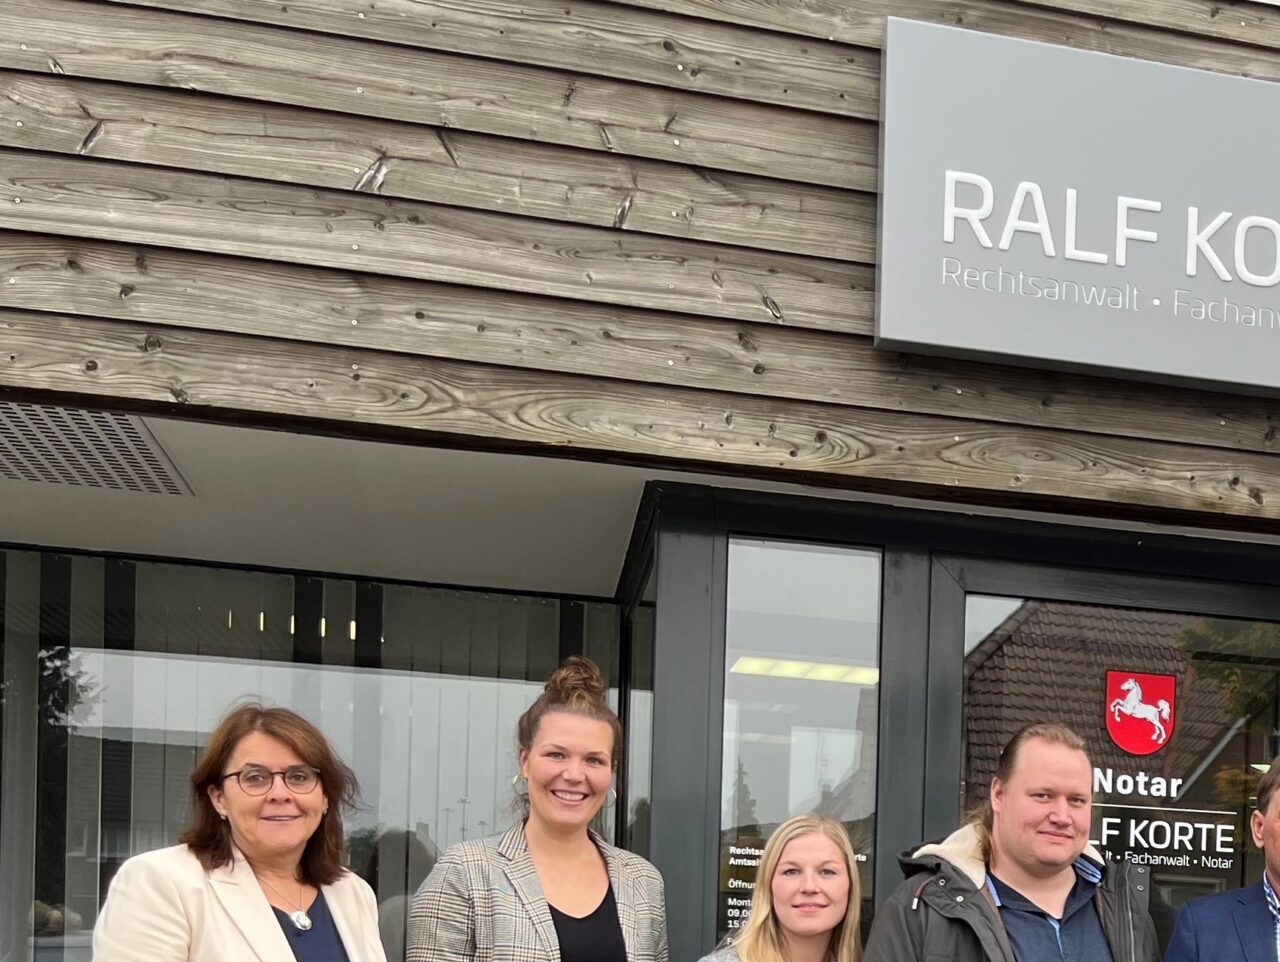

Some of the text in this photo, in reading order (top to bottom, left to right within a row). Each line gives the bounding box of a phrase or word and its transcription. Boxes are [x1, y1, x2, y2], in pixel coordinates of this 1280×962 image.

[943, 170, 1162, 267] RALF
[942, 257, 1141, 311] Rechtsanwalt
[1093, 767, 1183, 798] Notar
[1129, 818, 1235, 853] KORTE
[1124, 851, 1190, 867] Fachanwalt
[1201, 855, 1234, 869] Notar
